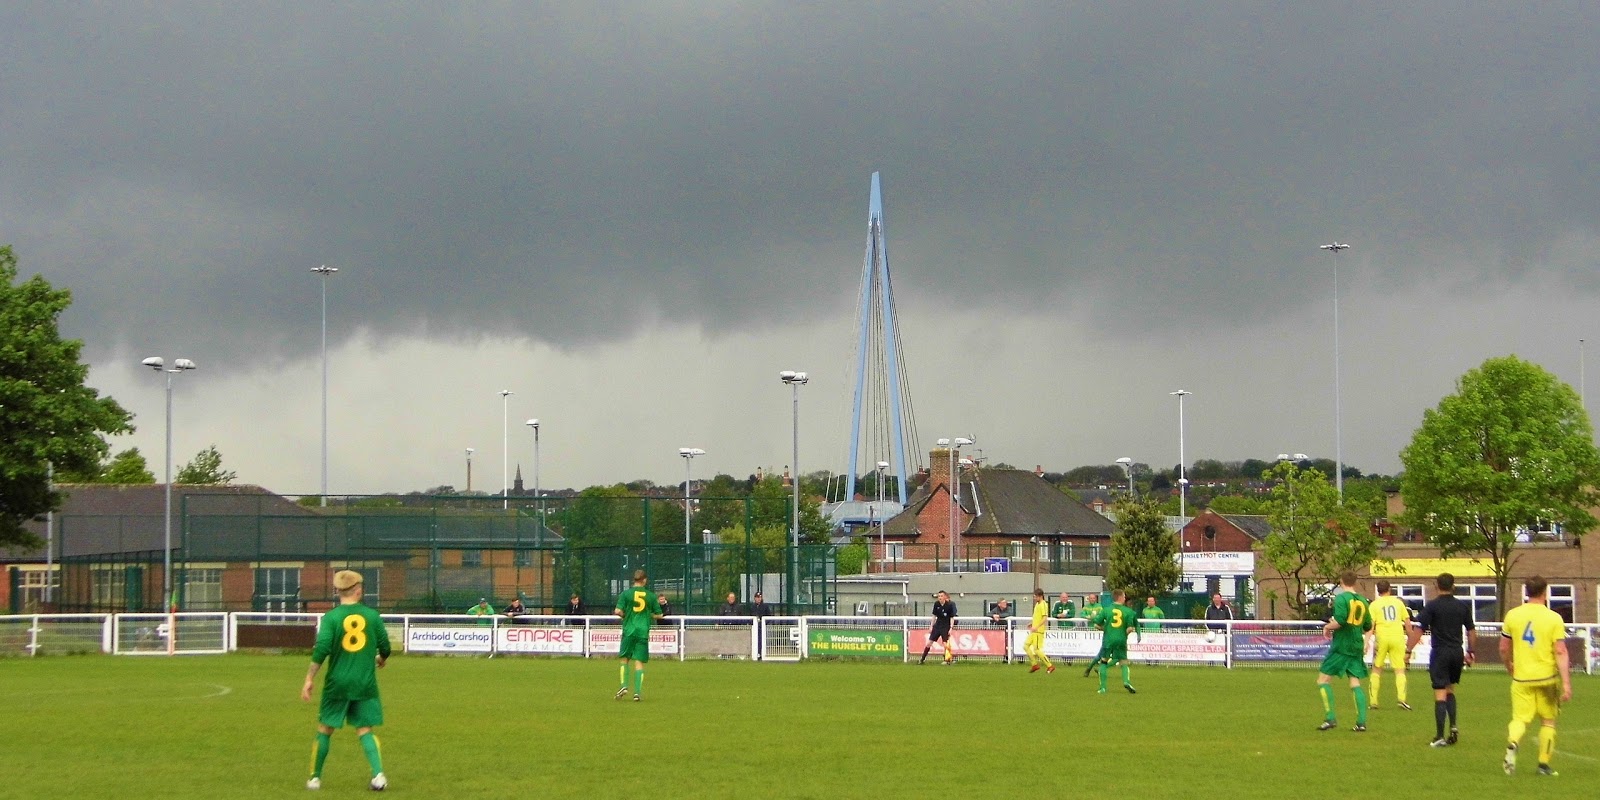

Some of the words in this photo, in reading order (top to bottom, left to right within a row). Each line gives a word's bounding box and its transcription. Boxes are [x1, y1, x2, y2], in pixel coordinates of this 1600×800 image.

[633, 591, 646, 612] 5
[1111, 608, 1123, 628] 3
[1347, 599, 1365, 626] 10
[1382, 605, 1396, 621] 10
[342, 614, 366, 652] 8
[412, 631, 451, 641] Archbold
[453, 632, 490, 643] Carshop
[506, 629, 573, 643] EMPIRE
[830, 635, 865, 643] Welcome
[1521, 621, 1536, 646] 4
[811, 642, 829, 650] THE
[831, 643, 873, 651] HUNSLET
[875, 643, 899, 651] CLUB
[1177, 645, 1204, 653] SPARES
